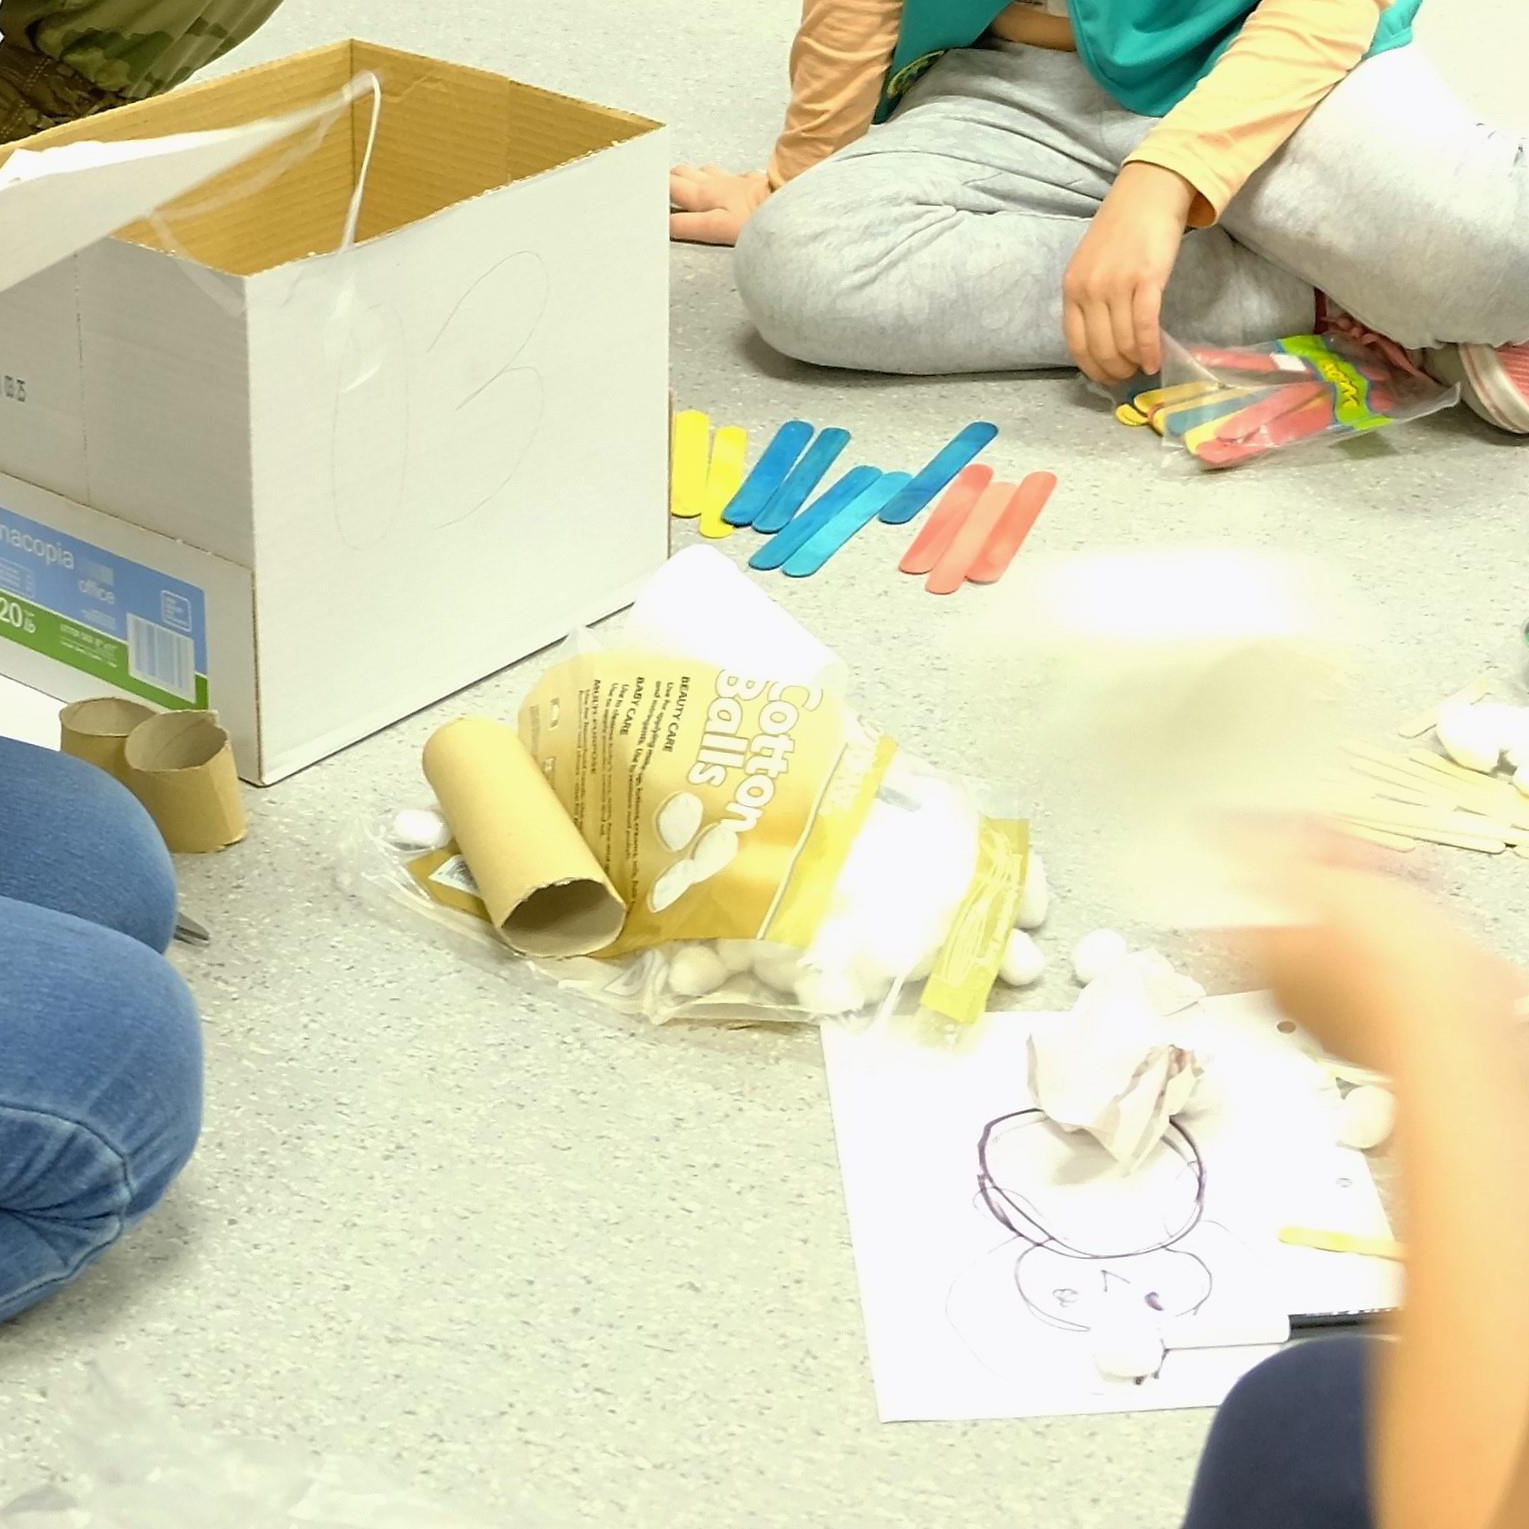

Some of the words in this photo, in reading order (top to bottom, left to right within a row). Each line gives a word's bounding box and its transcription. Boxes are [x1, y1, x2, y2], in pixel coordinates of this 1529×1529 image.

[78, 578, 115, 605] office
[631, 676, 645, 707] BABY
[671, 675, 691, 721] BEAUTY
[619, 707, 636, 736] CARE
[688, 666, 770, 788] Balls
[662, 722, 680, 753] CARE
[719, 677, 824, 833] Cotton
